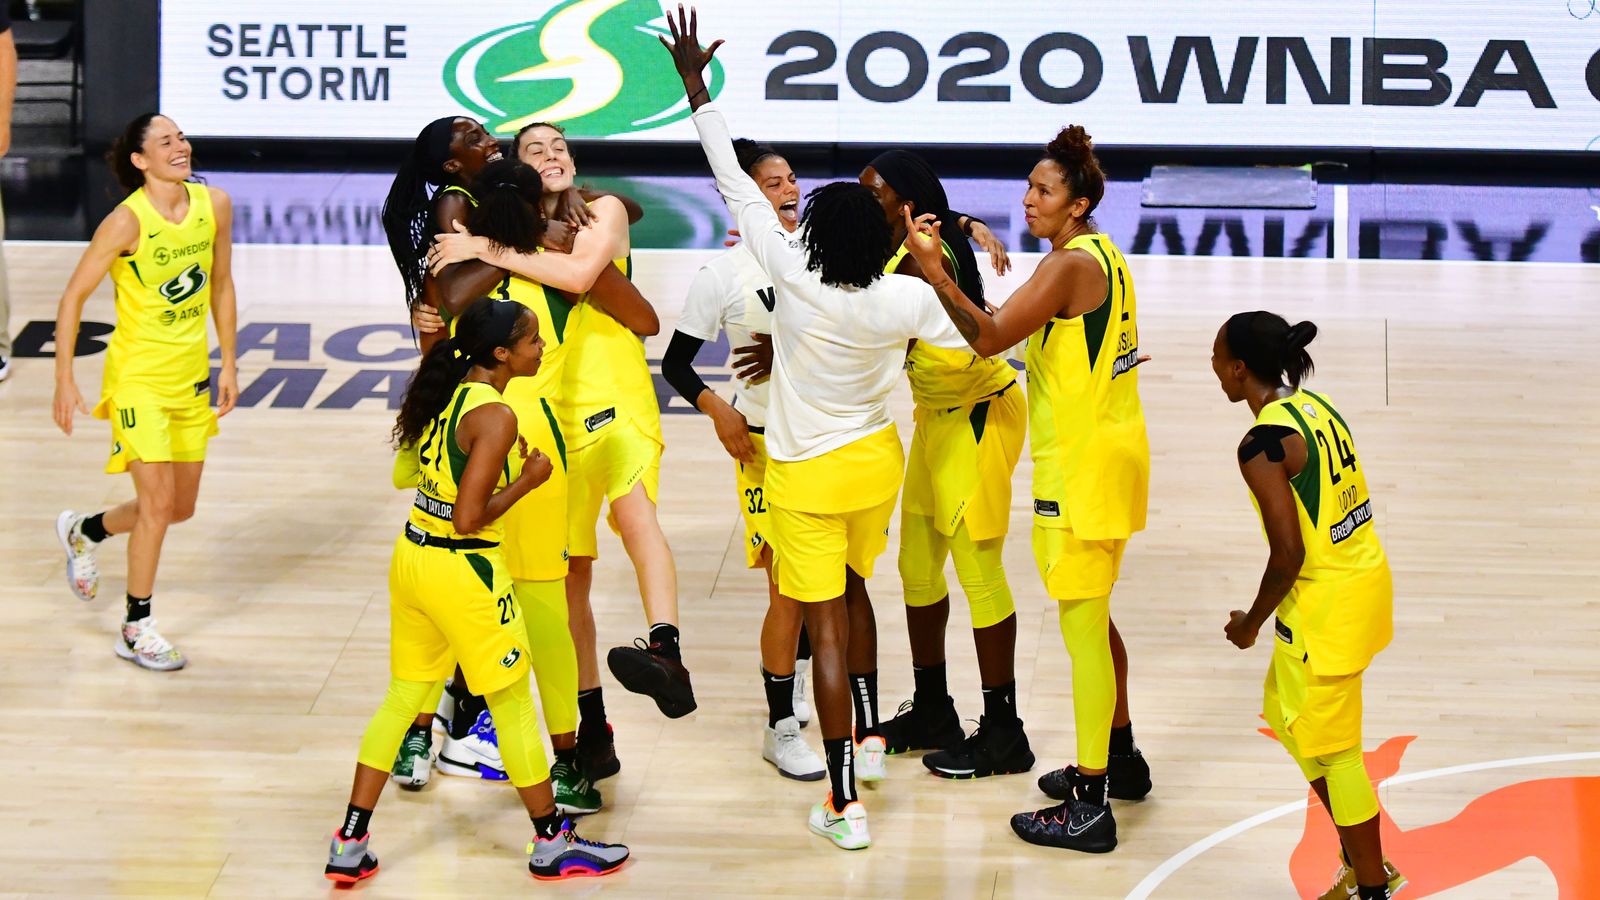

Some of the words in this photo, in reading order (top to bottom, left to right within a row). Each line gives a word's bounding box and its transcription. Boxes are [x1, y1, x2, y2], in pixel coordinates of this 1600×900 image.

[207, 23, 407, 59] SEATTLE
[222, 66, 390, 101] STORM
[765, 30, 1103, 104] 2020
[1127, 35, 1558, 108] WNBA
[172, 240, 210, 259] SWEDISH
[1117, 266, 1129, 321] 2
[179, 303, 204, 321] AT&T
[1315, 418, 1356, 485] 24
[427, 497, 453, 520] TAYLOR
[745, 486, 767, 514] 32
[1337, 484, 1358, 513] LOYD
[1352, 500, 1373, 525] TAYLO
[497, 592, 516, 626] 21
